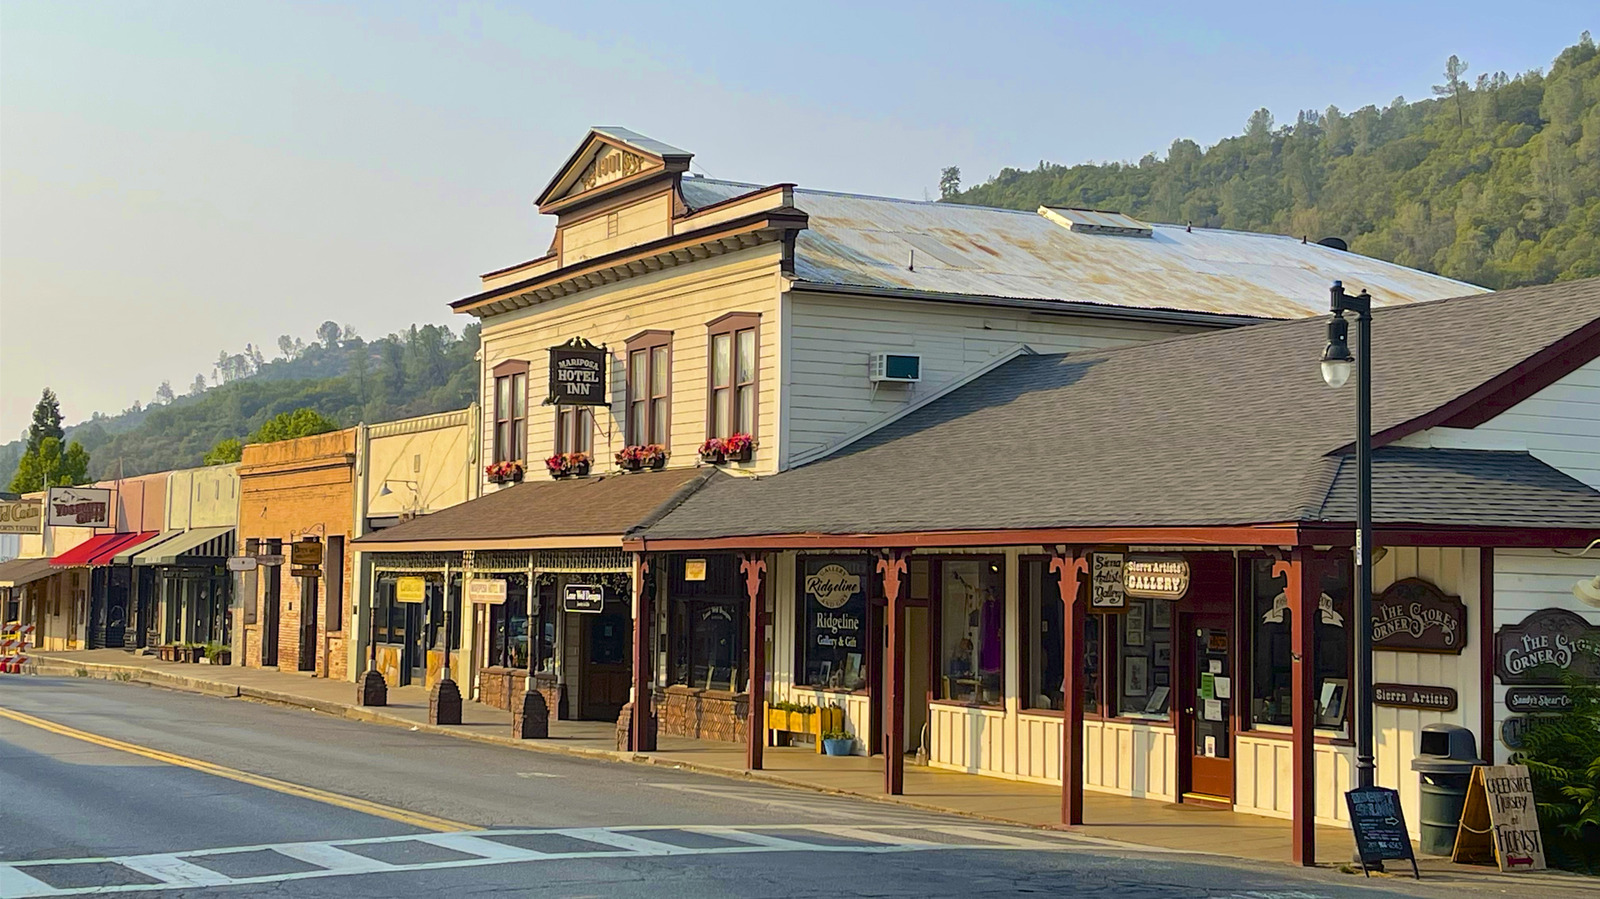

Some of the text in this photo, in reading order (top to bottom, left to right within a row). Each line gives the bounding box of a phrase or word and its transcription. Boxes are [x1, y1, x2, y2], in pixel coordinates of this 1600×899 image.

[558, 358, 599, 371] MARIPOSA
[558, 369, 599, 383] HOTEL
[566, 383, 591, 395] INN
[1128, 561, 1181, 574] Sierra Artists
[807, 577, 858, 598] Ridgeline
[1128, 575, 1180, 591] GALLERY
[1381, 604, 1403, 621] THE
[1409, 603, 1458, 638] STORES
[817, 612, 859, 634] Ridgeline
[817, 634, 837, 649] Gallery
[838, 635, 844, 646] &
[1521, 634, 1549, 652] THE
[1505, 648, 1554, 674] CORNER
[1376, 689, 1449, 705] Sierra Artists
[1495, 824, 1541, 856] FLORIST
